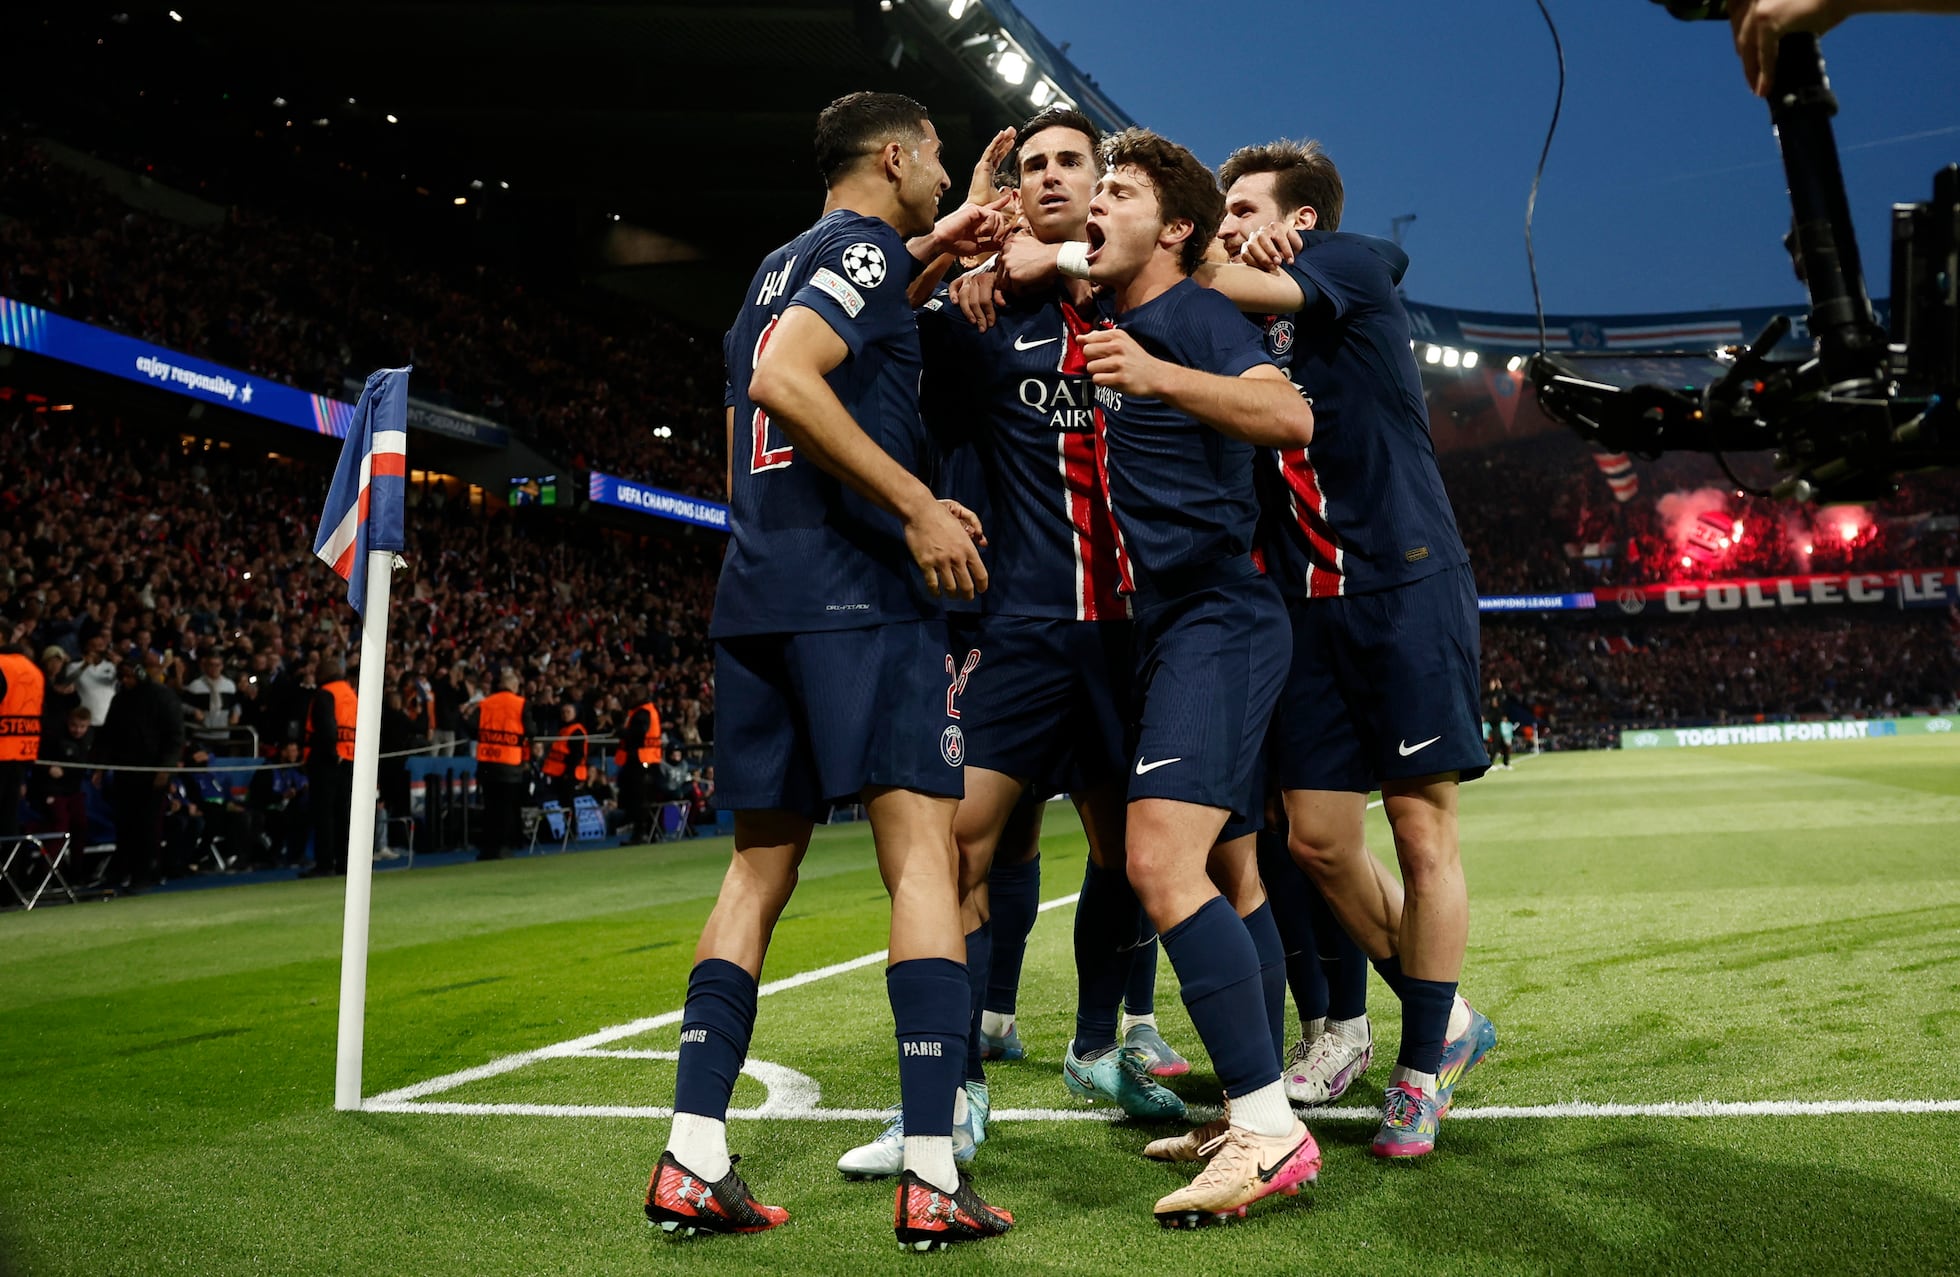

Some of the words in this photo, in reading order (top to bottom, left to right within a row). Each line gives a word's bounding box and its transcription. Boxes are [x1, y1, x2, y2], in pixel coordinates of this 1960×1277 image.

[136, 356, 171, 381] enjoy
[170, 366, 238, 401] responsibly
[617, 485, 642, 505] UEFA
[642, 491, 695, 518] CHAMPIONS
[694, 504, 727, 526] LEAGUE
[1664, 575, 1885, 612] COLLEC
[1902, 572, 1947, 601] LE
[1527, 596, 1563, 609] LEAGUE
[1675, 725, 1782, 747] TOGETHER
[1784, 722, 1827, 742] FOR
[1828, 719, 1898, 739] NATUR
[903, 1041, 942, 1057] PARIS
